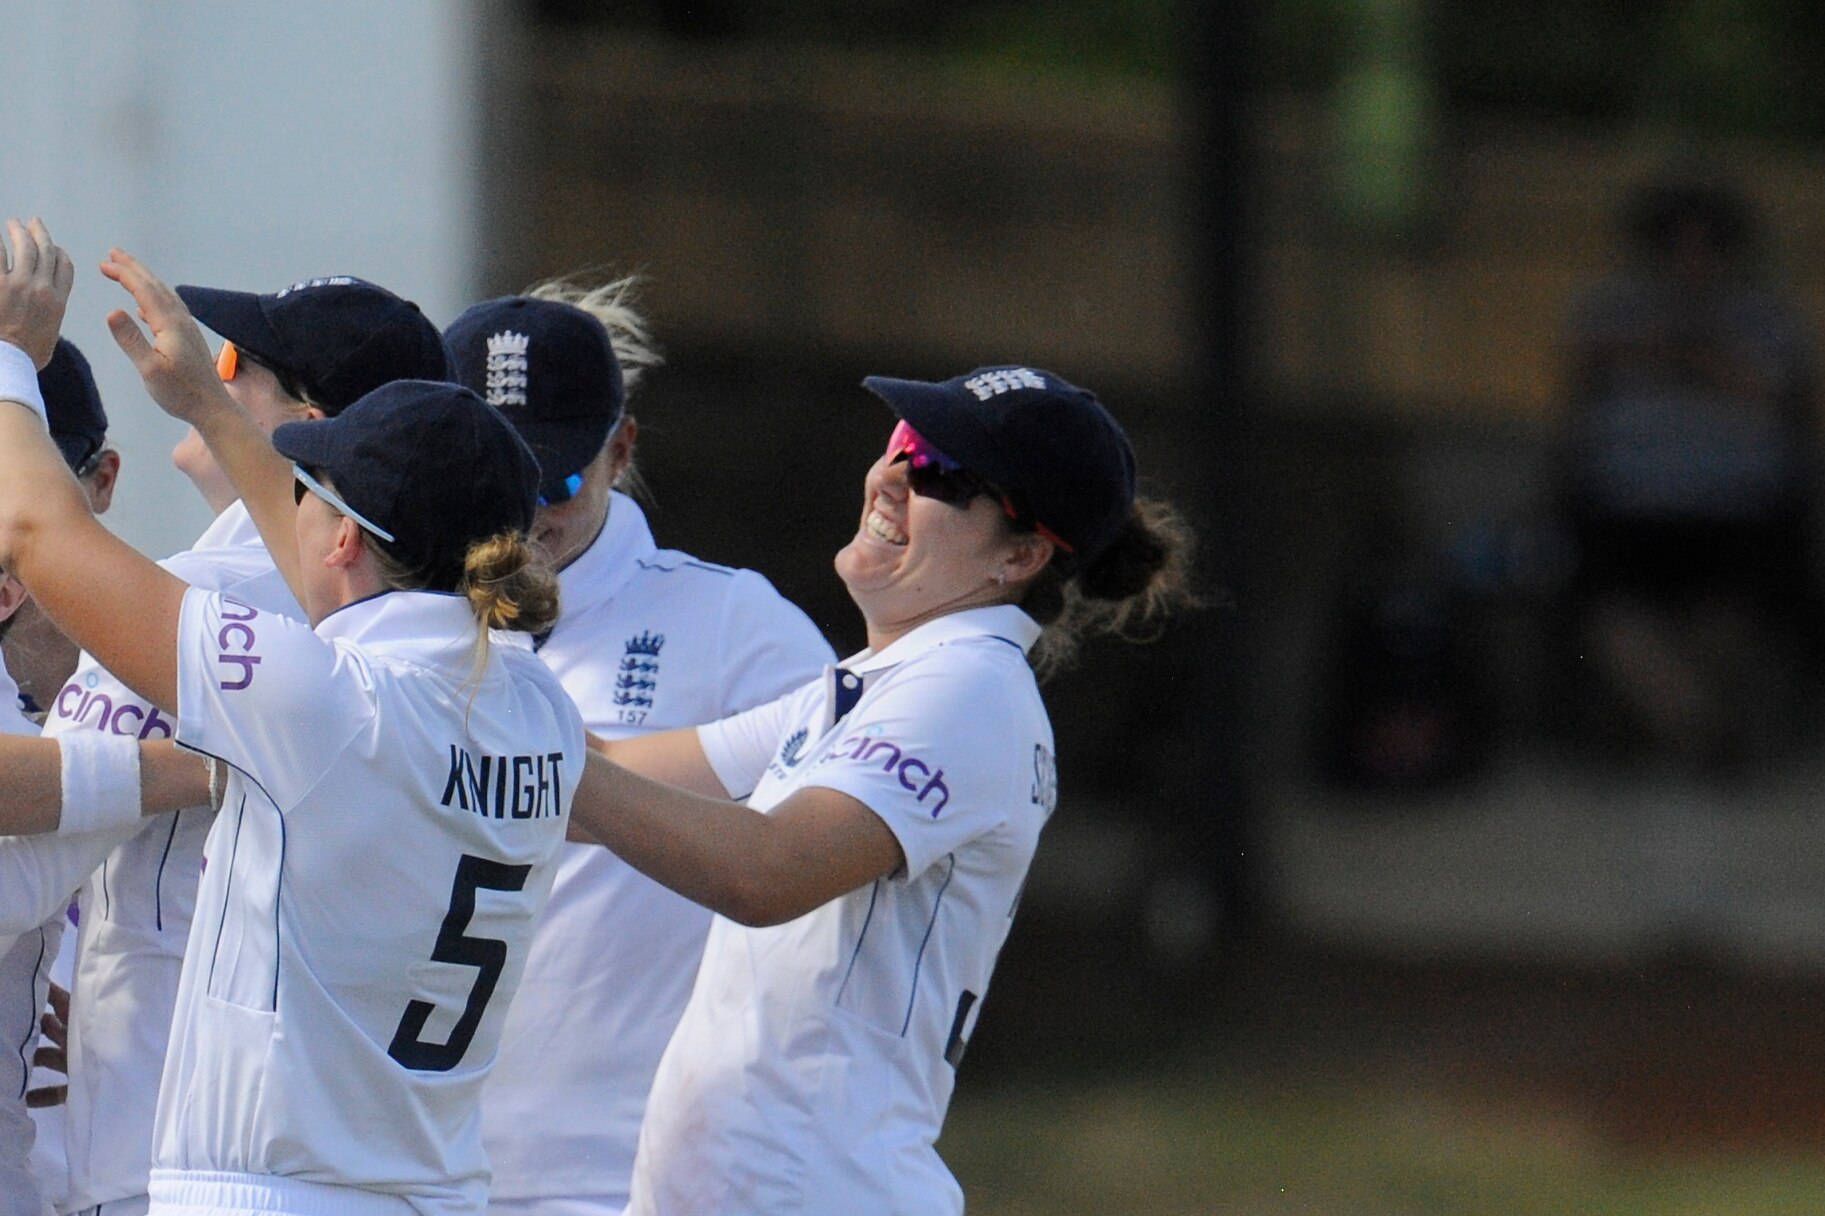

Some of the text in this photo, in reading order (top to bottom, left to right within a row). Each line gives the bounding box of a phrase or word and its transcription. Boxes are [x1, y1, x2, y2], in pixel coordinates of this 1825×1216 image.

[58, 672, 172, 740] cinch
[619, 710, 647, 726] 157
[441, 744, 564, 819] KNIGHT
[387, 854, 533, 1072] 5
